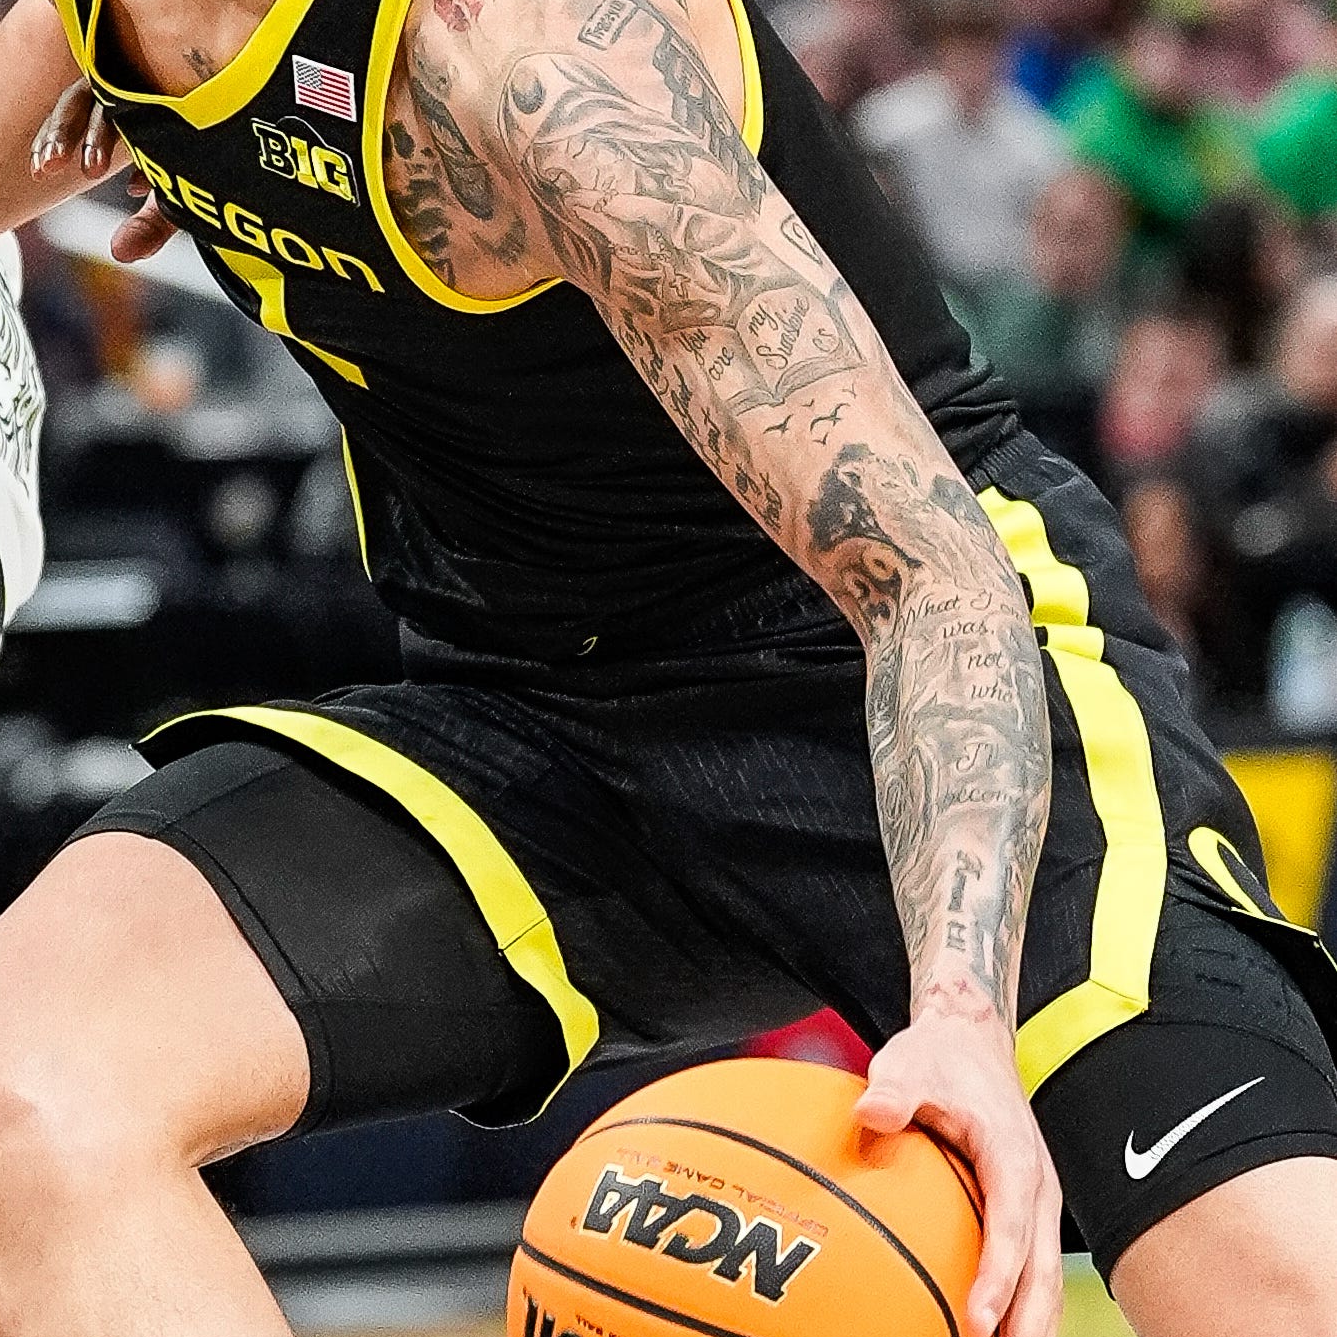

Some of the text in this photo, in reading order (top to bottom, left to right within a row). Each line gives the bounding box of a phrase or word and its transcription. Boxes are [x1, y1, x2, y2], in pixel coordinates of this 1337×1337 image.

[113, 120, 385, 294] REGON
[748, 303, 778, 338] my
[755, 295, 810, 370] Sunshine
[673, 326, 711, 366] You
[709, 346, 735, 381] are
[967, 651, 1004, 670] not
[971, 677, 1013, 701] who
[580, 1163, 821, 1306] NCAA
